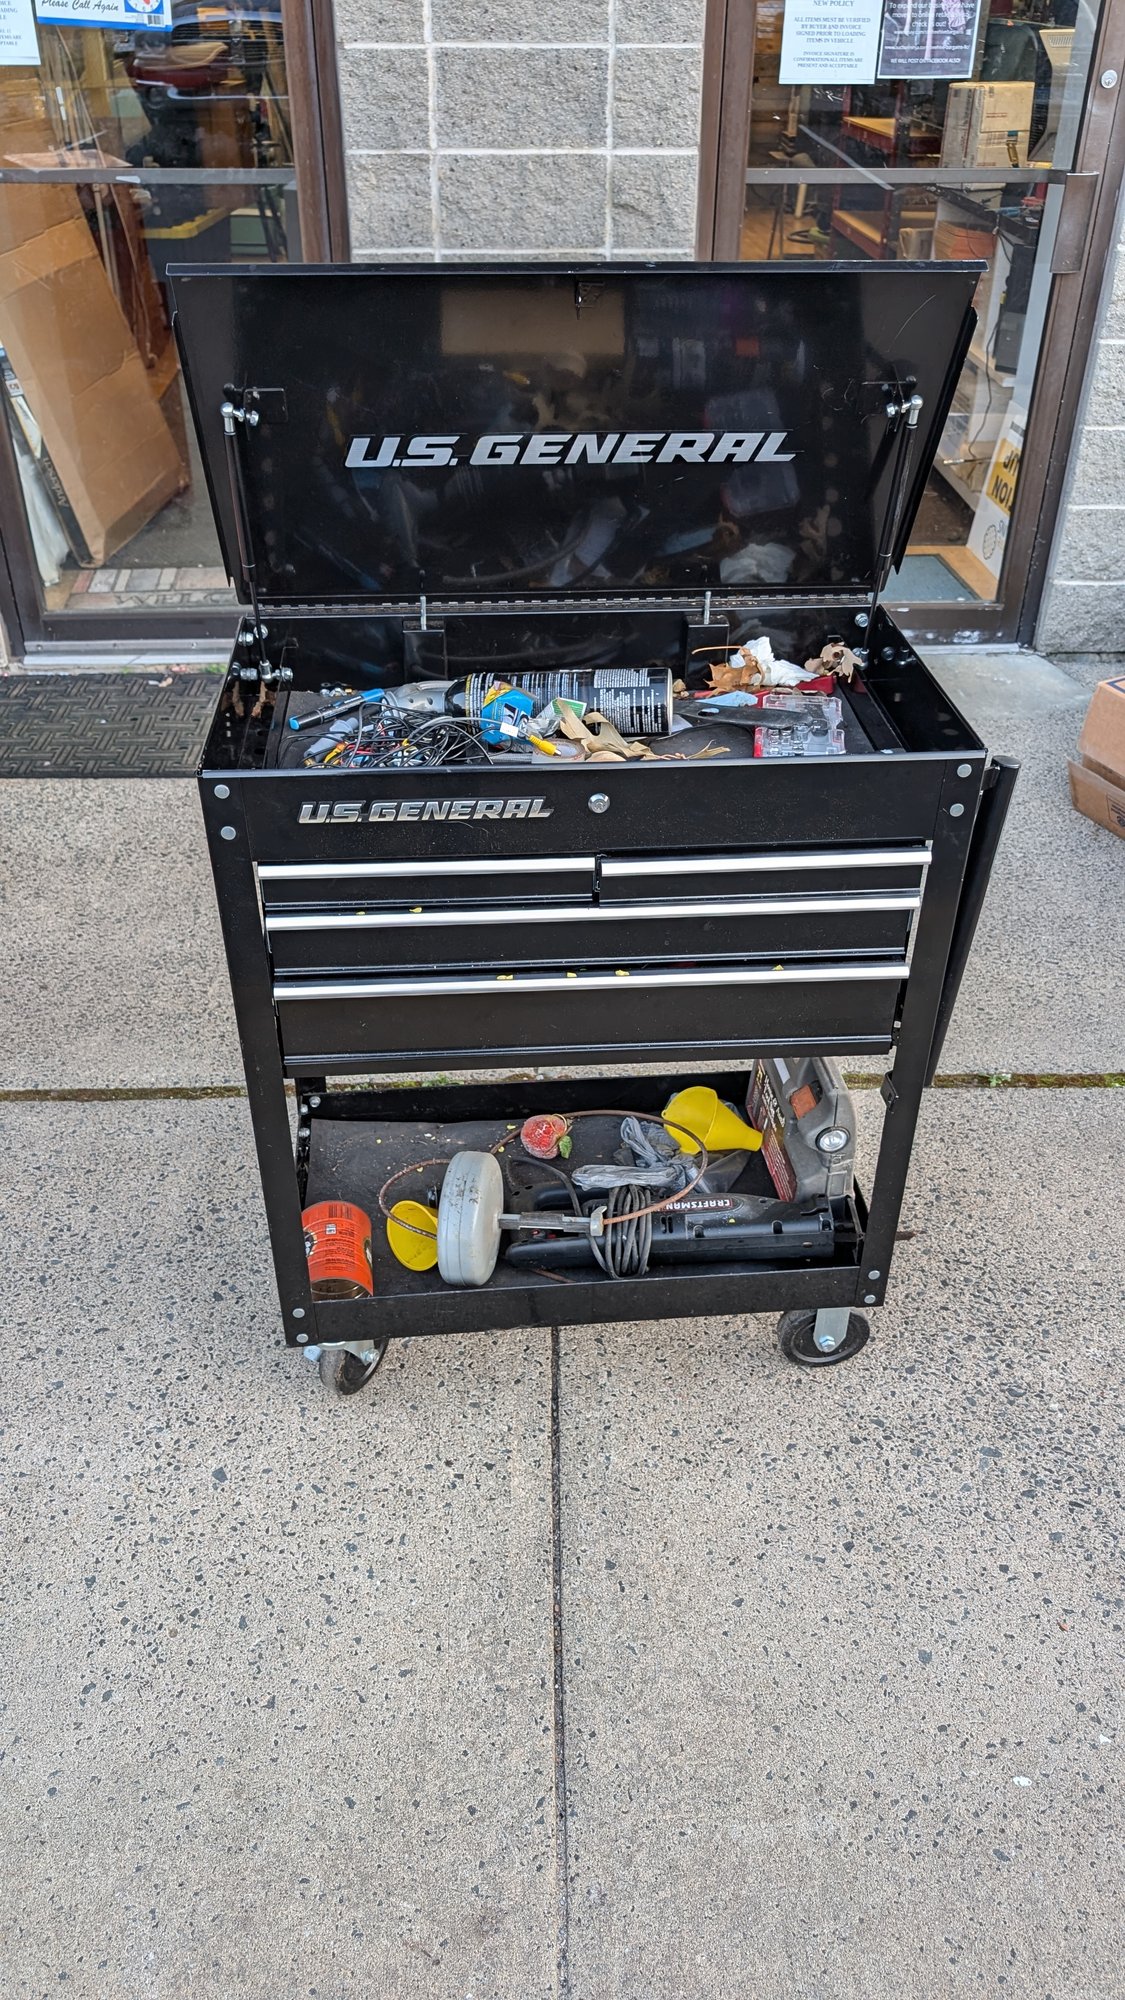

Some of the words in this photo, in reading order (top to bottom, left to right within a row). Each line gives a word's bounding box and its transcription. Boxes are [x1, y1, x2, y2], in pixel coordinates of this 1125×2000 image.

[41, 0, 68, 8] Please
[71, 0, 91, 10] Call
[92, 2, 119, 13] Again
[345, 436, 460, 467] U.S.
[469, 432, 796, 466] GENERAL
[43, 456, 70, 508] Andersen
[992, 474, 1014, 511] ION
[298, 801, 362, 824] U.S.
[368, 798, 552, 822] GENERAL
[666, 1199, 730, 1210] CRAFTSMAN
